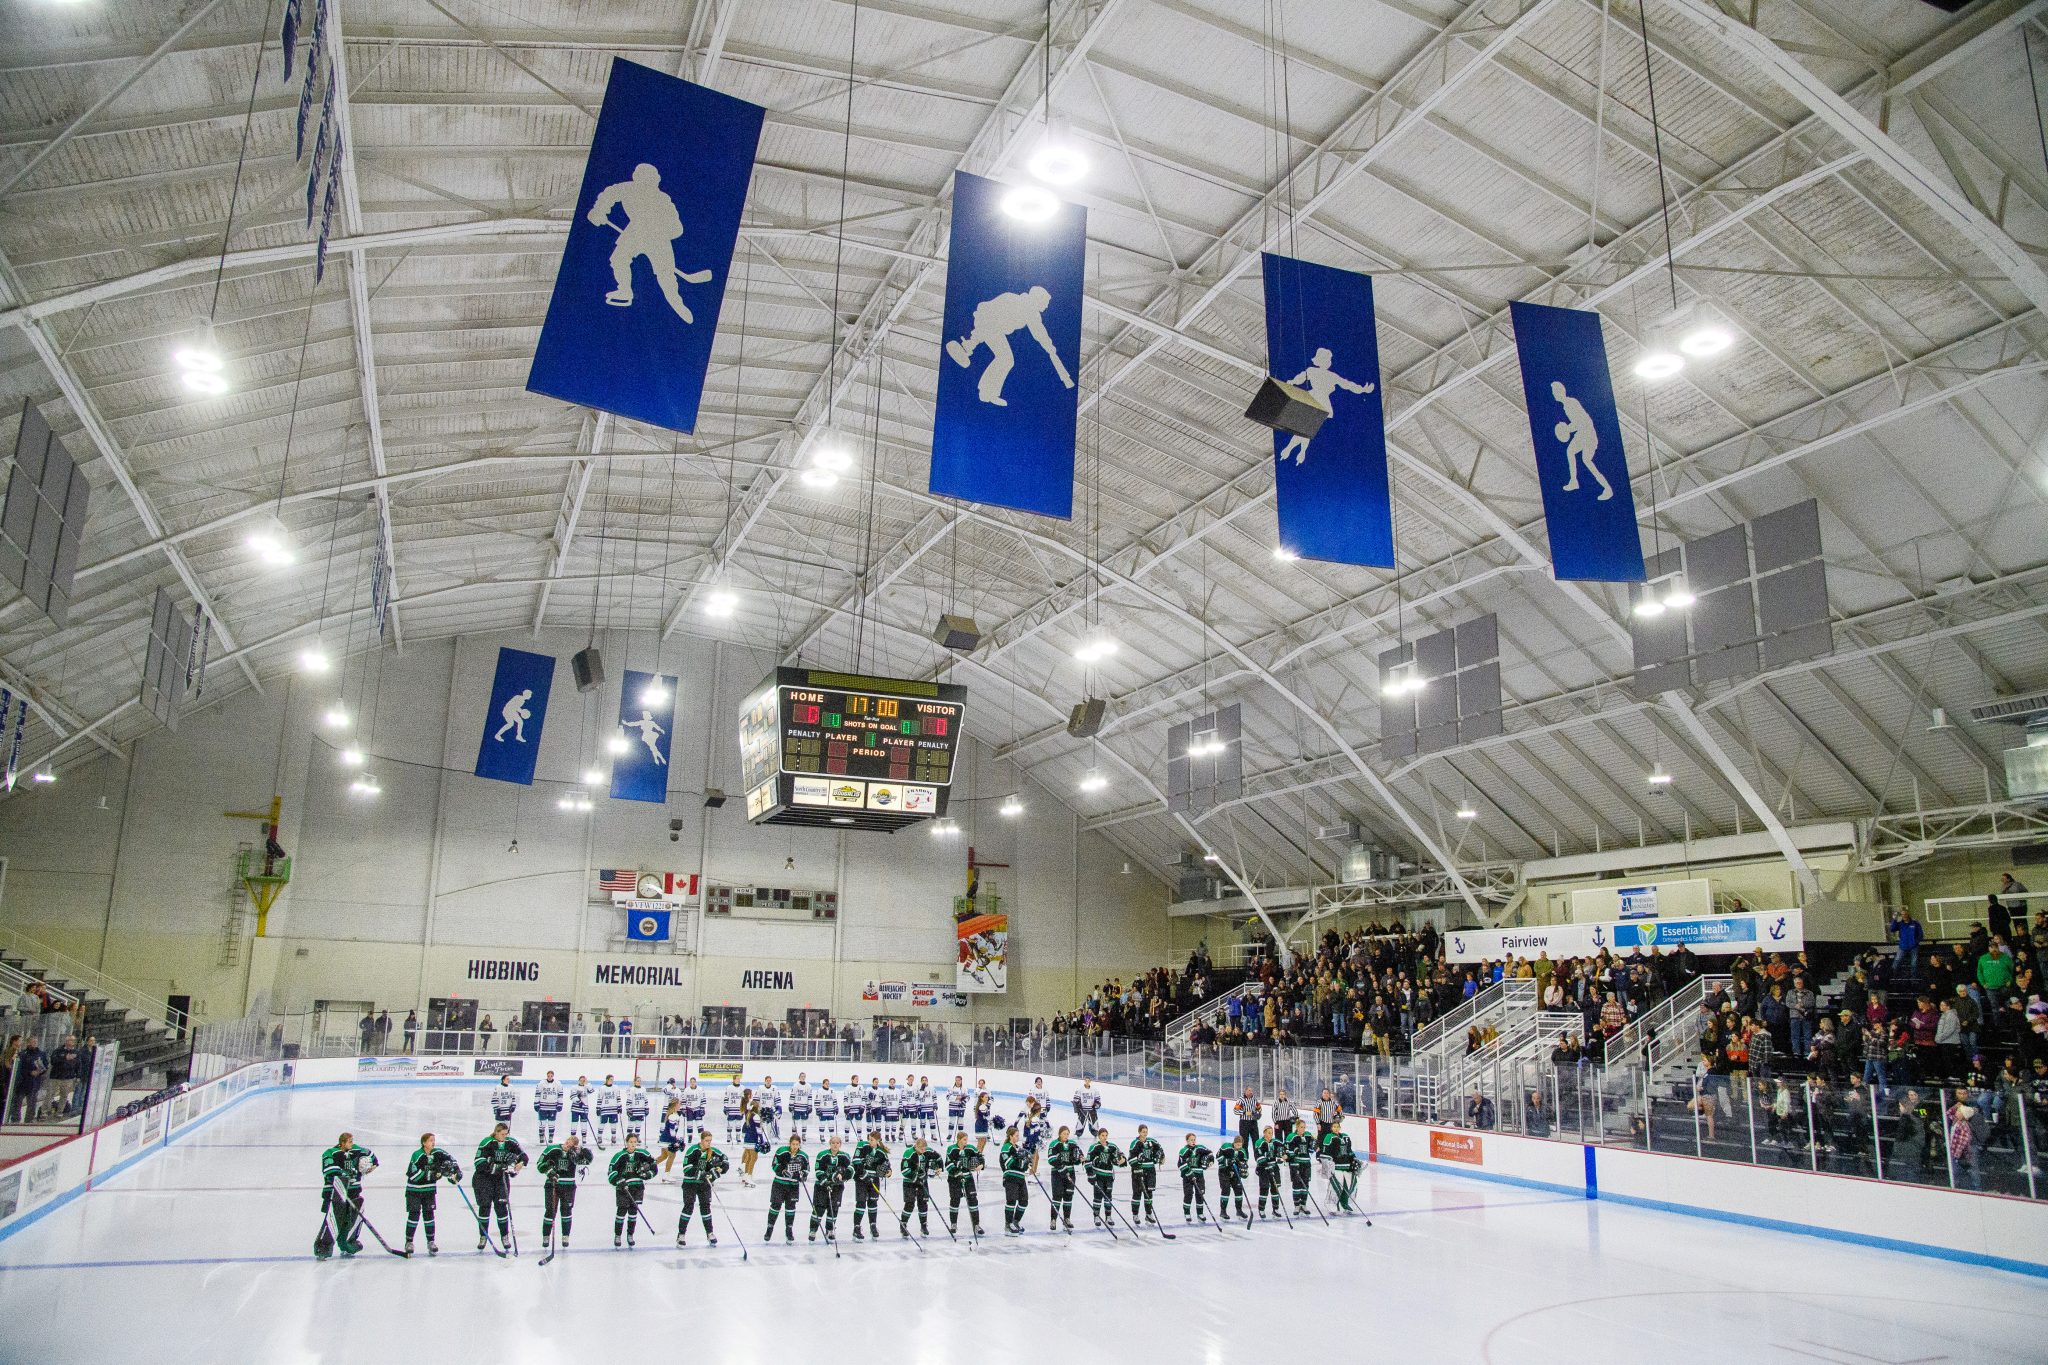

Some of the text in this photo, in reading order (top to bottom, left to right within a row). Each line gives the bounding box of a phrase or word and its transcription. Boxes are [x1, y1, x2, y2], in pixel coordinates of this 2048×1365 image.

[790, 691, 824, 703] HOME
[916, 703, 956, 716] VISITOR
[844, 720, 866, 728] SHOTS
[880, 723, 898, 731] GOAL
[788, 729, 821, 738] PENALTY
[825, 733, 858, 742] PLAYER
[883, 738, 915, 747] PLAYER
[918, 741, 949, 750] PENALTY
[853, 748, 886, 757] PERIOD
[1662, 923, 1730, 936] Essentia Health
[1502, 935, 1548, 948] Fairview
[467, 959, 539, 981] HIBBING
[595, 964, 683, 986] MEMORIAL
[741, 970, 794, 989] ARENA
[441, 1064, 460, 1072] Therapy
